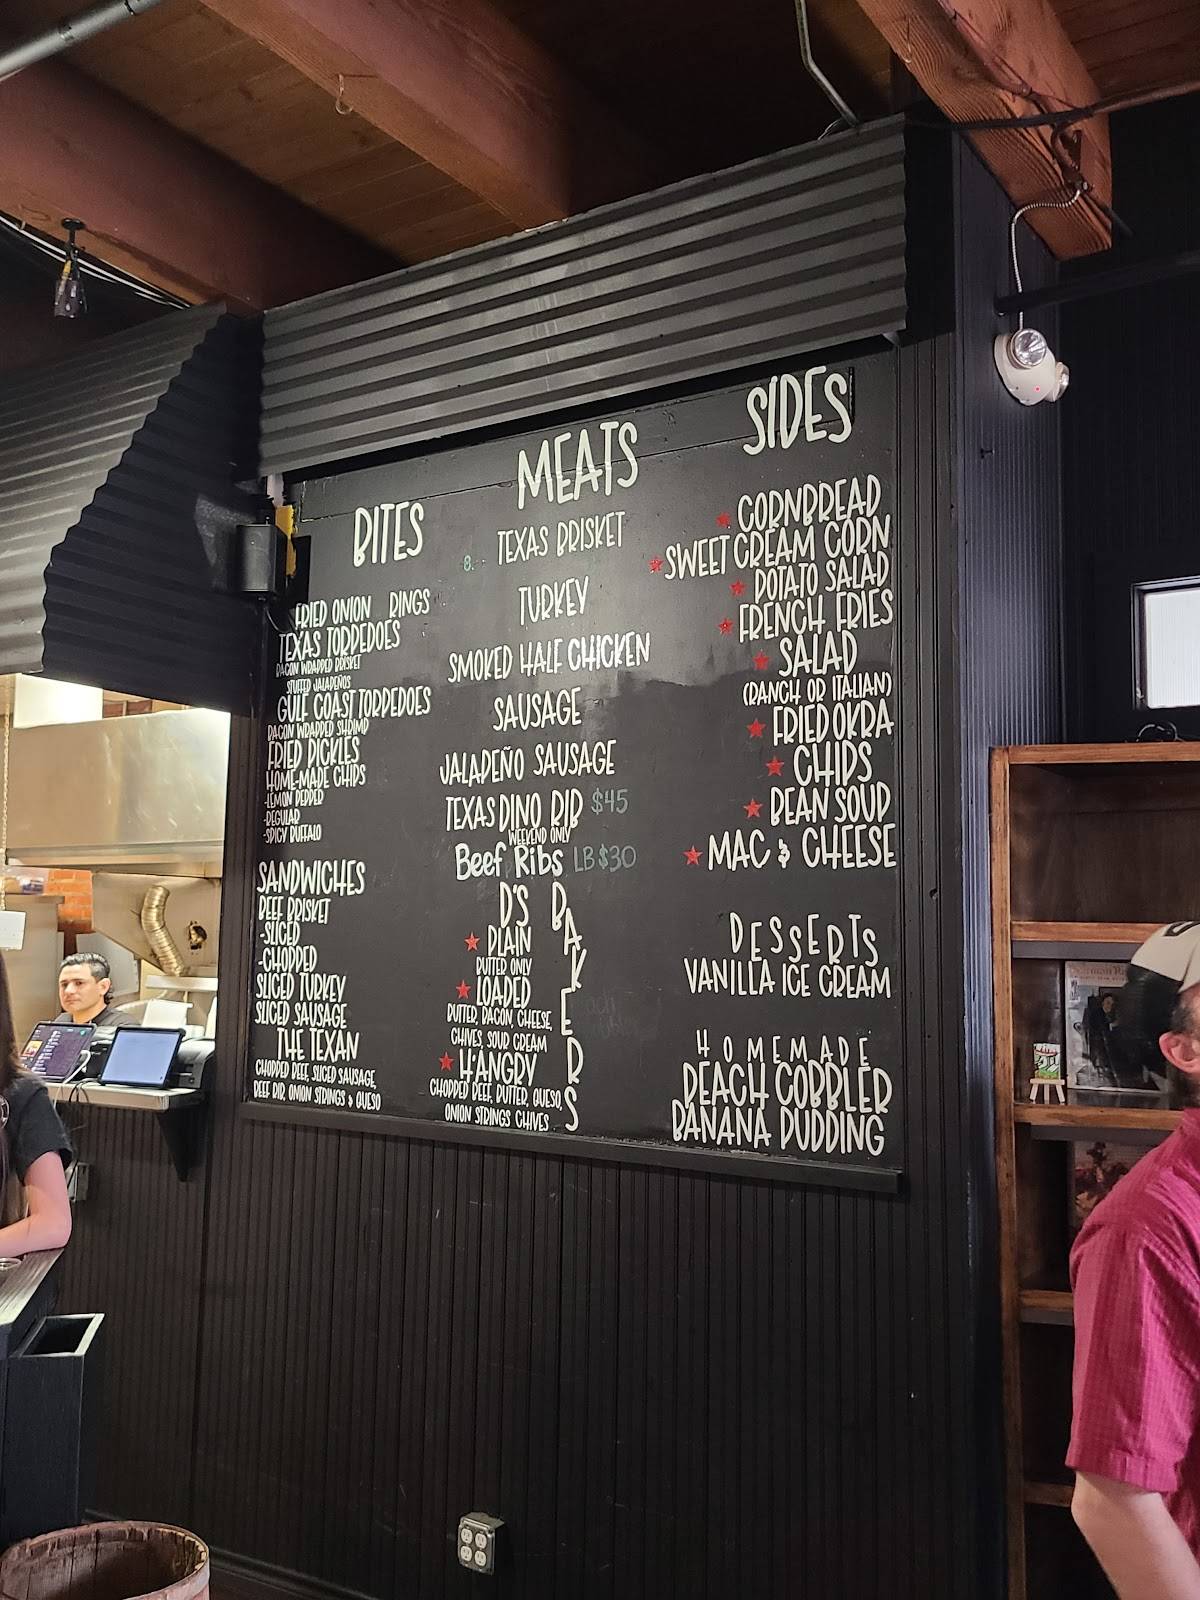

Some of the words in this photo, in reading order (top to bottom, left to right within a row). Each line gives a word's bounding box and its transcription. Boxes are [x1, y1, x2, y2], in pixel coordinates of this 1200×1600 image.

[743, 365, 852, 456] SIDES
[517, 421, 639, 510] MEATS
[737, 474, 882, 532] CORNBREAD
[353, 501, 424, 567] BITES
[497, 525, 549, 566] TEXAS
[556, 511, 626, 557] BRISKET
[665, 534, 730, 580] SWEET
[734, 525, 815, 569] CREAM
[824, 514, 891, 559] CORN
[754, 562, 819, 604] POTATO
[825, 550, 890, 592] SALAD
[295, 600, 328, 630] FRIED
[332, 595, 371, 625] ONION
[389, 588, 431, 618] RINGS
[517, 575, 590, 626] TURKEY
[740, 594, 826, 643] FRENCH
[836, 588, 893, 632] FRIES
[279, 631, 321, 663] TEXAS
[327, 619, 401, 657] TORPEDOES
[448, 643, 513, 684] SMOKED
[519, 638, 564, 677] HALF
[567, 631, 651, 672] CHICKEN
[778, 629, 858, 678] SALAD
[301, 659, 333, 675] WRAPPED
[335, 654, 362, 672] BRISKET
[277, 693, 311, 723] GULF
[313, 689, 357, 720] COAST
[358, 686, 431, 719] TORPEDOES
[286, 678, 311, 694] STUFFED
[743, 677, 802, 706] (RANCH
[806, 677, 827, 703] OR
[832, 671, 893, 702] ITALIAN)
[492, 687, 582, 732] SAUSAGE
[773, 703, 830, 747] FRIED
[832, 698, 895, 741] OKRA
[267, 724, 294, 741] BACON
[297, 720, 334, 739] WRAPPED
[336, 717, 369, 736] SHRIMP
[267, 739, 302, 771] FRIED
[307, 736, 360, 768] PICKLES
[439, 745, 525, 787] JALAPEÑO
[533, 739, 617, 778] SAUSAGE
[793, 739, 873, 787] CHIPS
[266, 765, 330, 791] HOME-MADE
[333, 763, 366, 788] CHIPS
[295, 789, 324, 806] PEPPER
[445, 795, 496, 832] TEXAS
[499, 792, 542, 833] DINO
[551, 788, 584, 829] RIB
[591, 787, 629, 815] $45
[770, 786, 830, 827] BEAN
[834, 781, 891, 823] SOUP
[289, 824, 322, 843] BUFFALO
[508, 827, 547, 846] WEEKEND
[549, 826, 573, 844] ONLY
[708, 828, 771, 872] MAC
[802, 823, 898, 870] CHEESE
[256, 859, 366, 896] SANDWICHES
[455, 841, 507, 881] Beef
[514, 844, 564, 879] Ribs
[573, 846, 595, 873] LB
[598, 843, 637, 873] $30
[258, 895, 284, 921] BEEF
[286, 897, 331, 925] BRISKET
[499, 881, 529, 929] D'S
[260, 921, 300, 946] -SLICED
[487, 924, 532, 957] PLAIN
[729, 911, 879, 968] DESSERTS
[257, 945, 317, 973] -CHOPPED
[476, 957, 507, 976] BUTTER
[510, 957, 532, 976] ONLY
[684, 957, 776, 996] VANILLA
[782, 963, 811, 997] ICE
[819, 965, 891, 999] CREAM
[255, 972, 295, 1001] SLICED
[299, 972, 347, 1002] TURKEY
[476, 975, 531, 1010] LOADED
[254, 1000, 290, 1026] SLICED
[293, 1001, 348, 1029] SAUSAGE
[447, 1003, 478, 1025] BUTTER,
[482, 1006, 513, 1029] BACON,
[517, 1009, 552, 1032] CHEESE,
[277, 1027, 305, 1062] THE
[309, 1027, 360, 1063] TEXAN
[487, 1030, 510, 1050] SOUR
[513, 1033, 547, 1053] CREAM
[255, 1059, 290, 1079] CHOPPED
[311, 1064, 337, 1084] SLICED
[338, 1066, 377, 1090] SAUSAGE,
[683, 1061, 770, 1111] PEACH
[775, 1059, 893, 1115] COBBLER
[253, 1080, 271, 1099] BEEF
[288, 1084, 312, 1103] ONION
[314, 1086, 346, 1107] STRINGS
[355, 1090, 381, 1111] QUESO
[429, 1078, 469, 1100] CHOPPED
[472, 1082, 493, 1104] BEEF,
[496, 1084, 529, 1108] BUTTER,
[533, 1087, 562, 1111] QUESO,
[444, 1103, 472, 1122] ONION
[475, 1105, 511, 1127] STRINGS
[515, 1110, 549, 1132] CHIVES
[672, 1099, 772, 1149] BANANA
[780, 1105, 885, 1156] PUDDING
